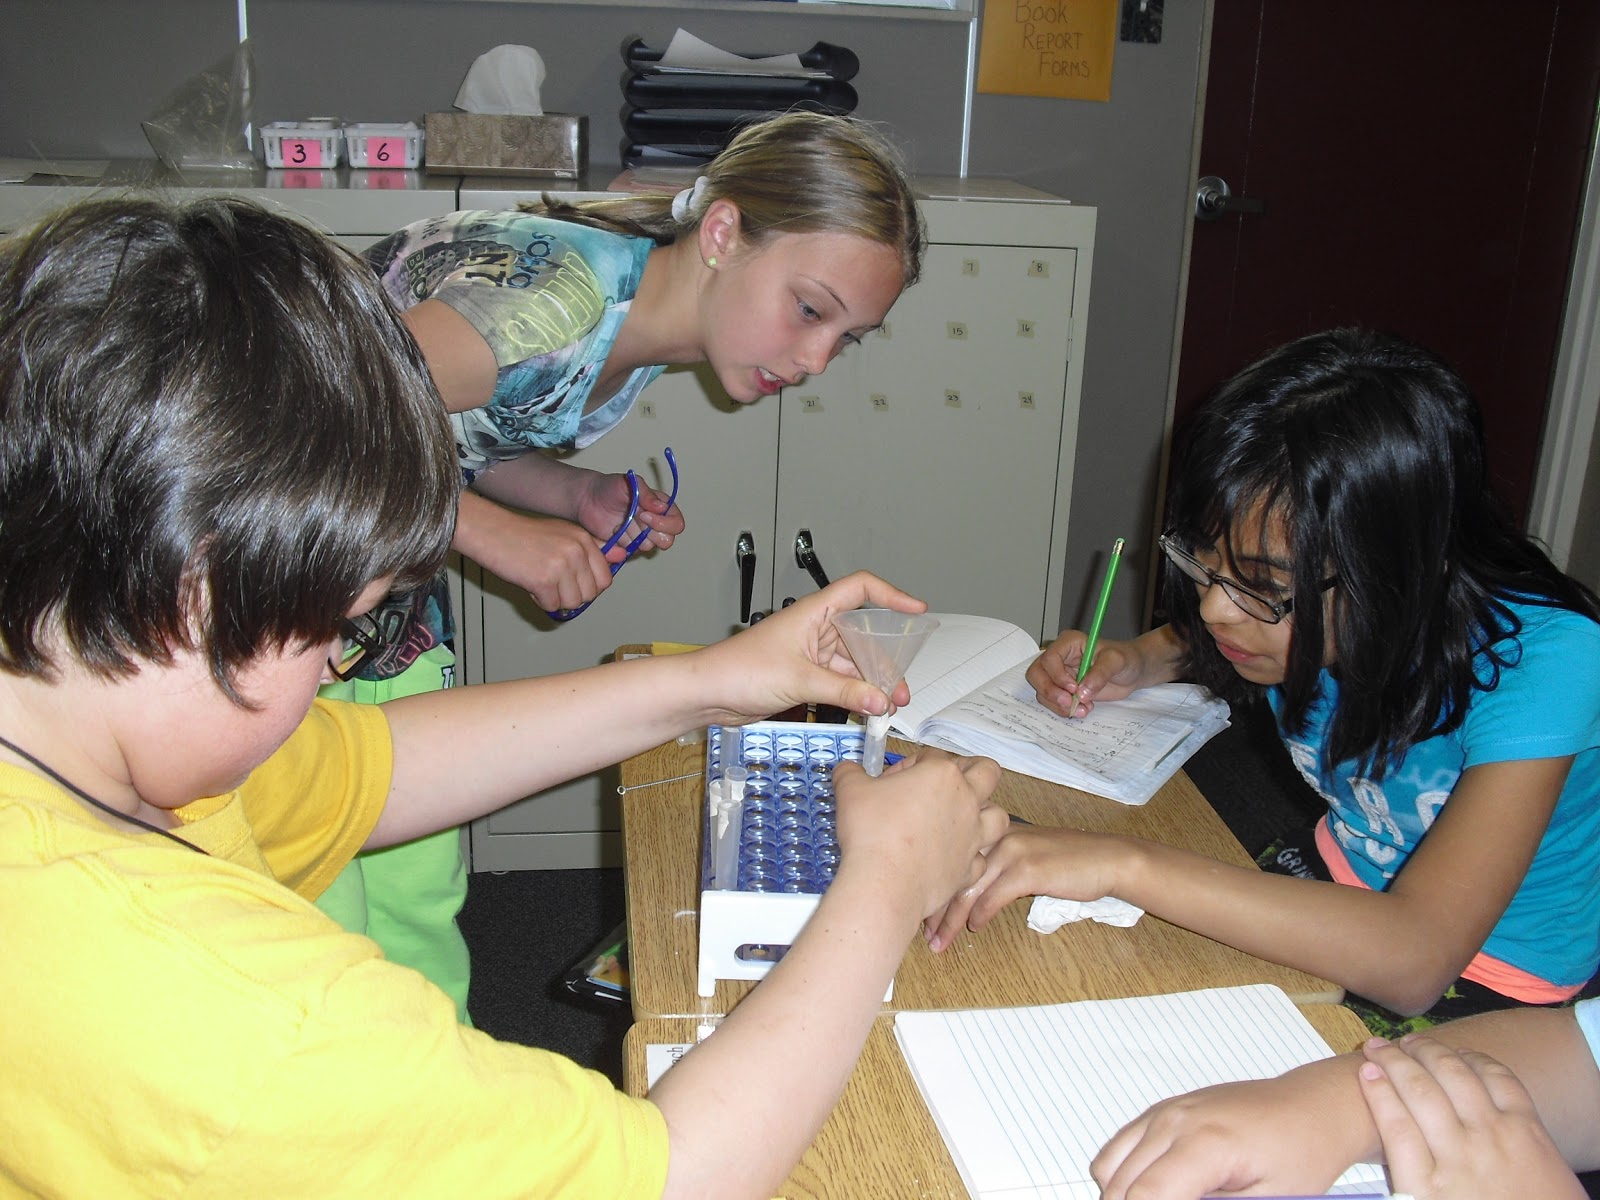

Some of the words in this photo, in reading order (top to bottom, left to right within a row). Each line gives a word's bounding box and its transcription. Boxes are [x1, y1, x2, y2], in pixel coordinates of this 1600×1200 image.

[1022, 23, 1083, 51] REPORT
[1039, 52, 1091, 79] FORMS
[292, 143, 307, 164] 3
[376, 142, 390, 162] 6
[952, 326, 964, 336] 15
[1021, 323, 1031, 333] 16
